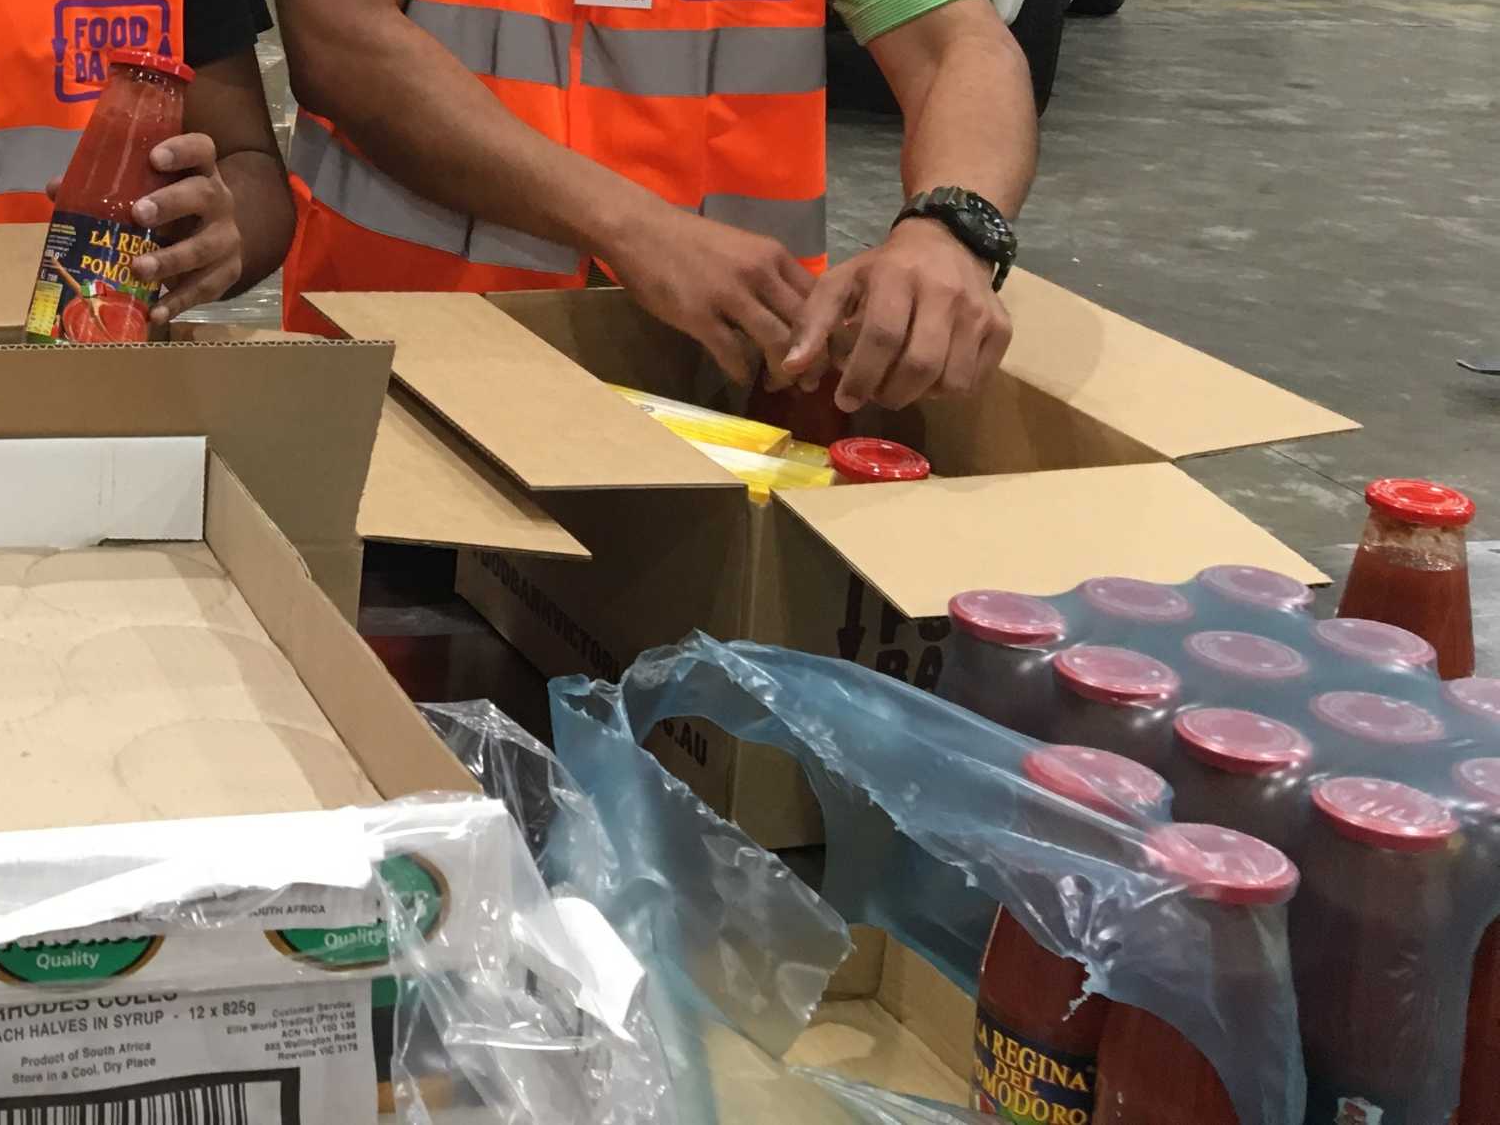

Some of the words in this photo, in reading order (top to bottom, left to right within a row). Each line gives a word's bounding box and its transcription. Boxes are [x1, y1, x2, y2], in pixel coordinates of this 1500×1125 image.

[75, 15, 149, 49] FOOD
[76, 50, 106, 83] BA
[89, 229, 114, 250] LA
[876, 647, 944, 690] BA
[286, 903, 327, 915] AFRICA
[324, 924, 387, 950] Quality
[36, 951, 100, 980] Quality
[29, 1017, 89, 1039] HALVES
[92, 1016, 109, 1030] IN
[113, 1010, 165, 1028] SYRUP
[189, 1007, 205, 1020] 12
[210, 1006, 218, 1018] x
[222, 1000, 256, 1017] 825g
[250, 1021, 278, 1032] World
[340, 1010, 356, 1020] Ltd
[282, 1028, 301, 1038] ACN
[319, 1045, 335, 1055] VIC
[334, 1032, 357, 1042] Road
[20, 1053, 65, 1067] Product
[68, 1049, 80, 1061] of
[82, 1044, 116, 1060] South
[119, 1040, 152, 1053] Africa
[991, 1028, 1090, 1093] REGINA
[11, 1072, 44, 1085] Store
[47, 1070, 58, 1082] in
[61, 1070, 68, 1080] a
[103, 1060, 122, 1075] Dry
[125, 1056, 157, 1069] Place
[994, 1058, 1039, 1096] DEL
